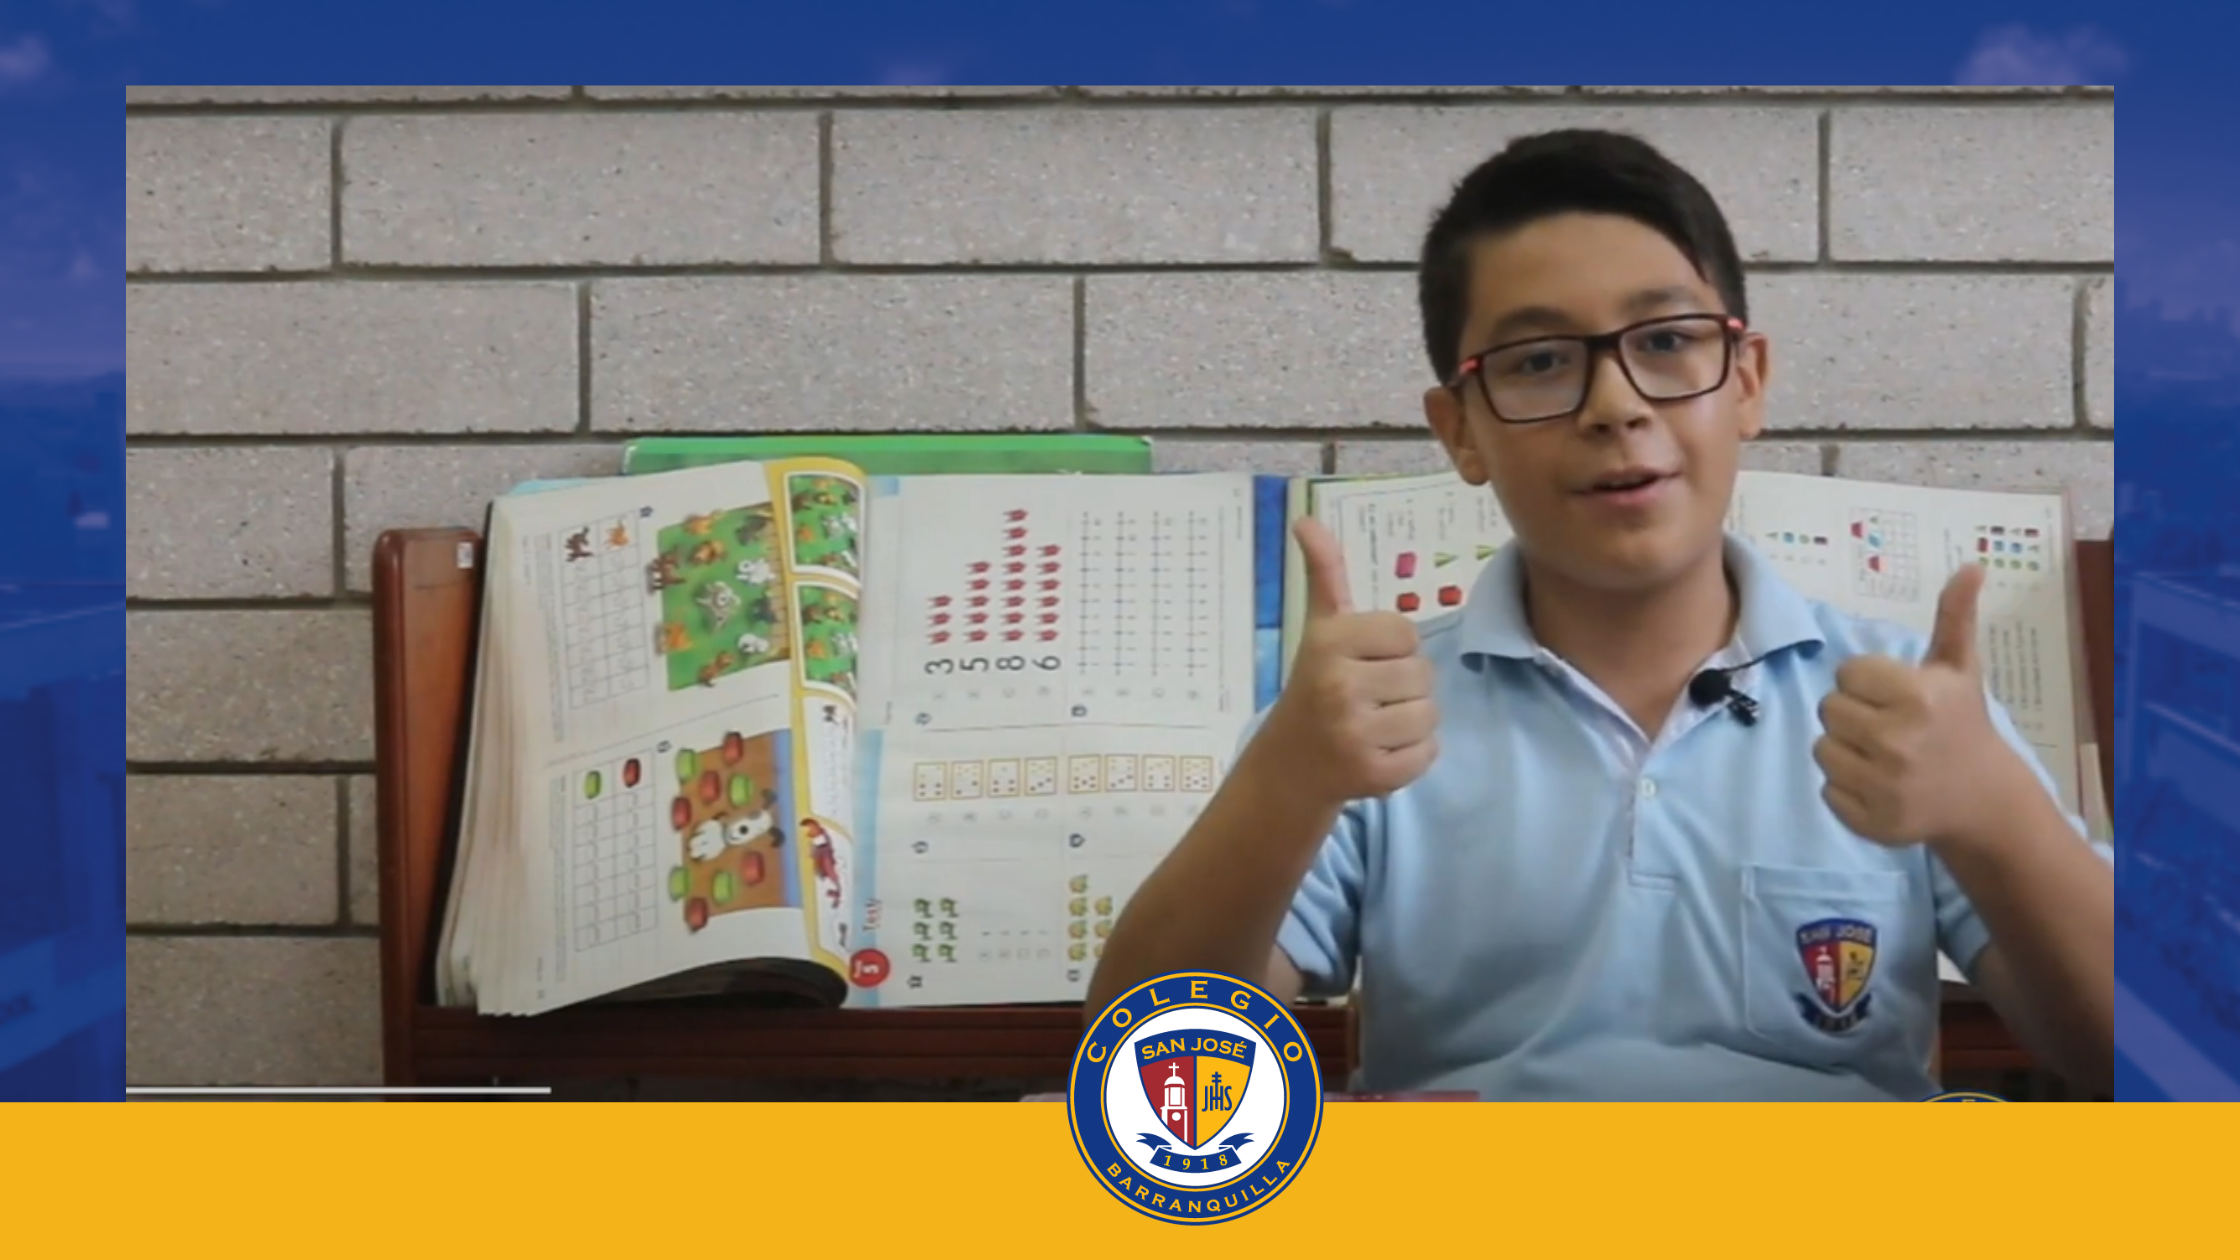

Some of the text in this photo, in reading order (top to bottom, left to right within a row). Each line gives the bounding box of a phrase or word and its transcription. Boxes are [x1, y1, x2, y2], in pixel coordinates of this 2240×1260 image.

[924, 658, 955, 675] 3
[959, 657, 990, 673] 5
[995, 655, 1026, 671] 8
[1031, 655, 1062, 671] 6
